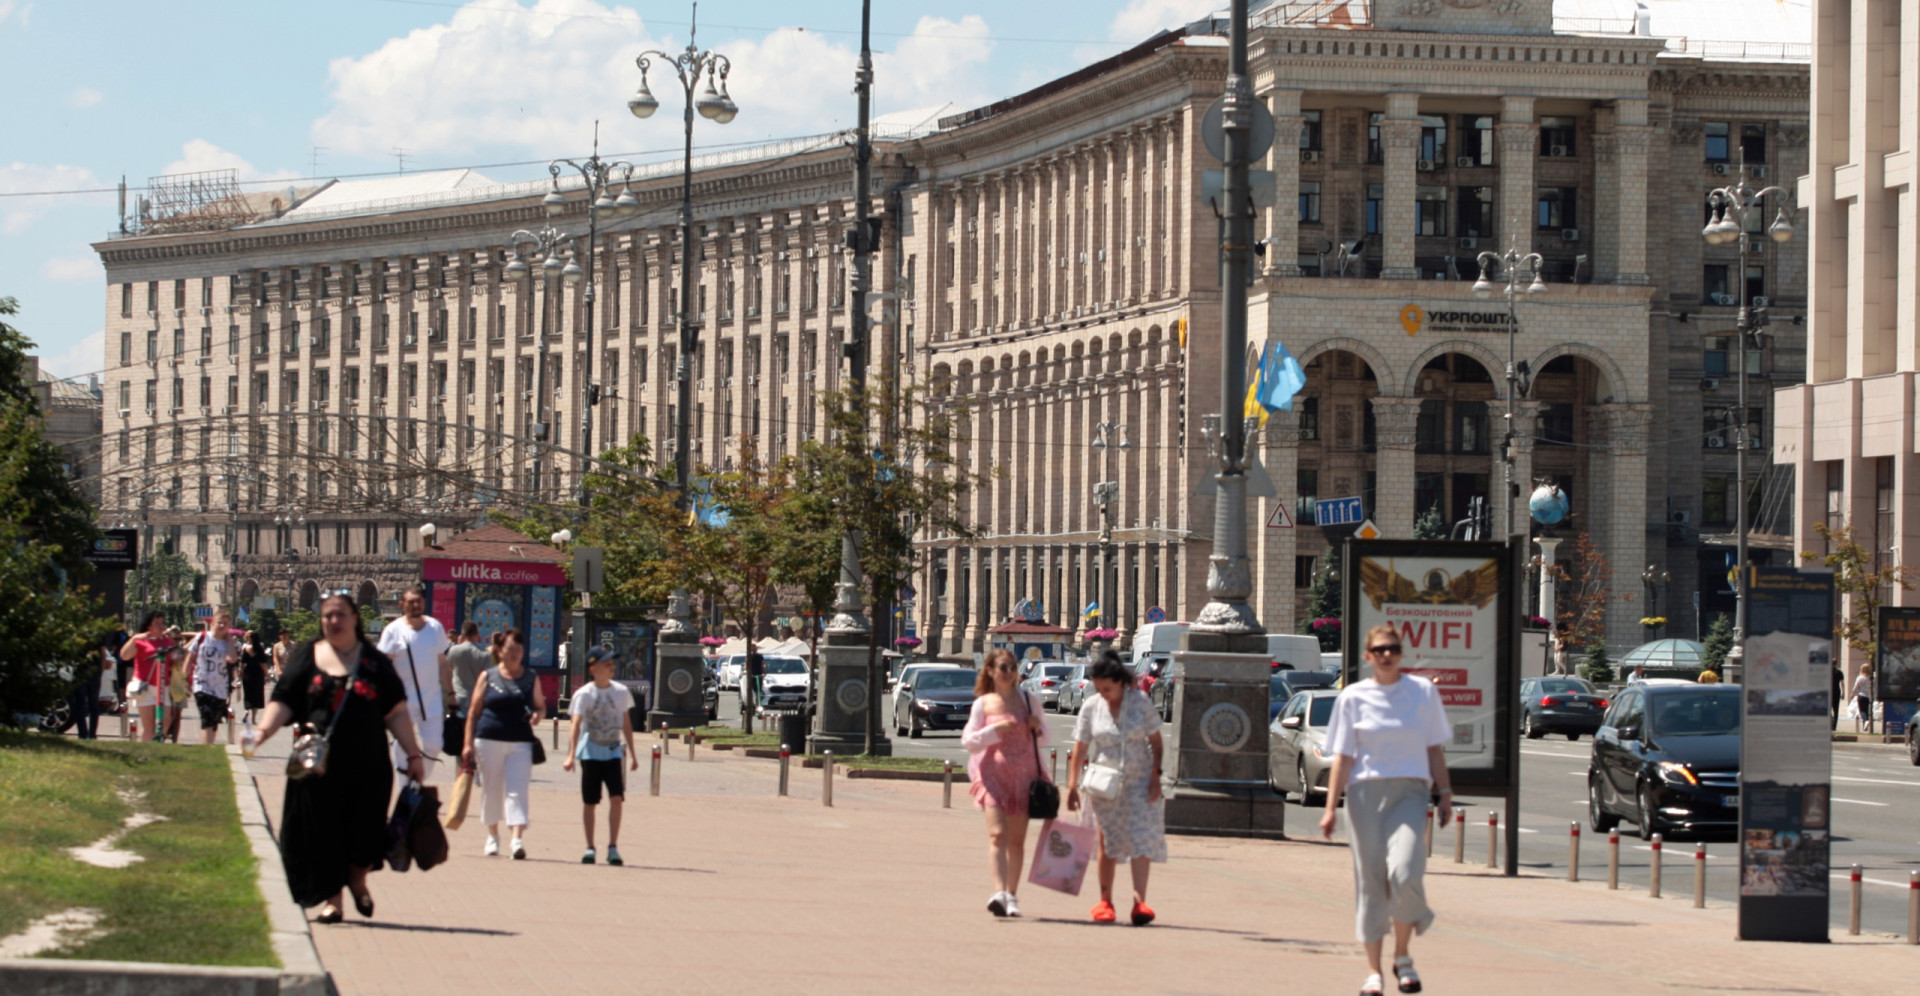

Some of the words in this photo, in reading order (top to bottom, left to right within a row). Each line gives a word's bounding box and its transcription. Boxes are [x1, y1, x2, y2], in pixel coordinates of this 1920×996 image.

[1428, 311, 1518, 324] УКРПОШТА
[503, 570, 539, 581] coffee
[1386, 607, 1473, 617] Безкоштовний
[1387, 621, 1472, 649] WIFI
